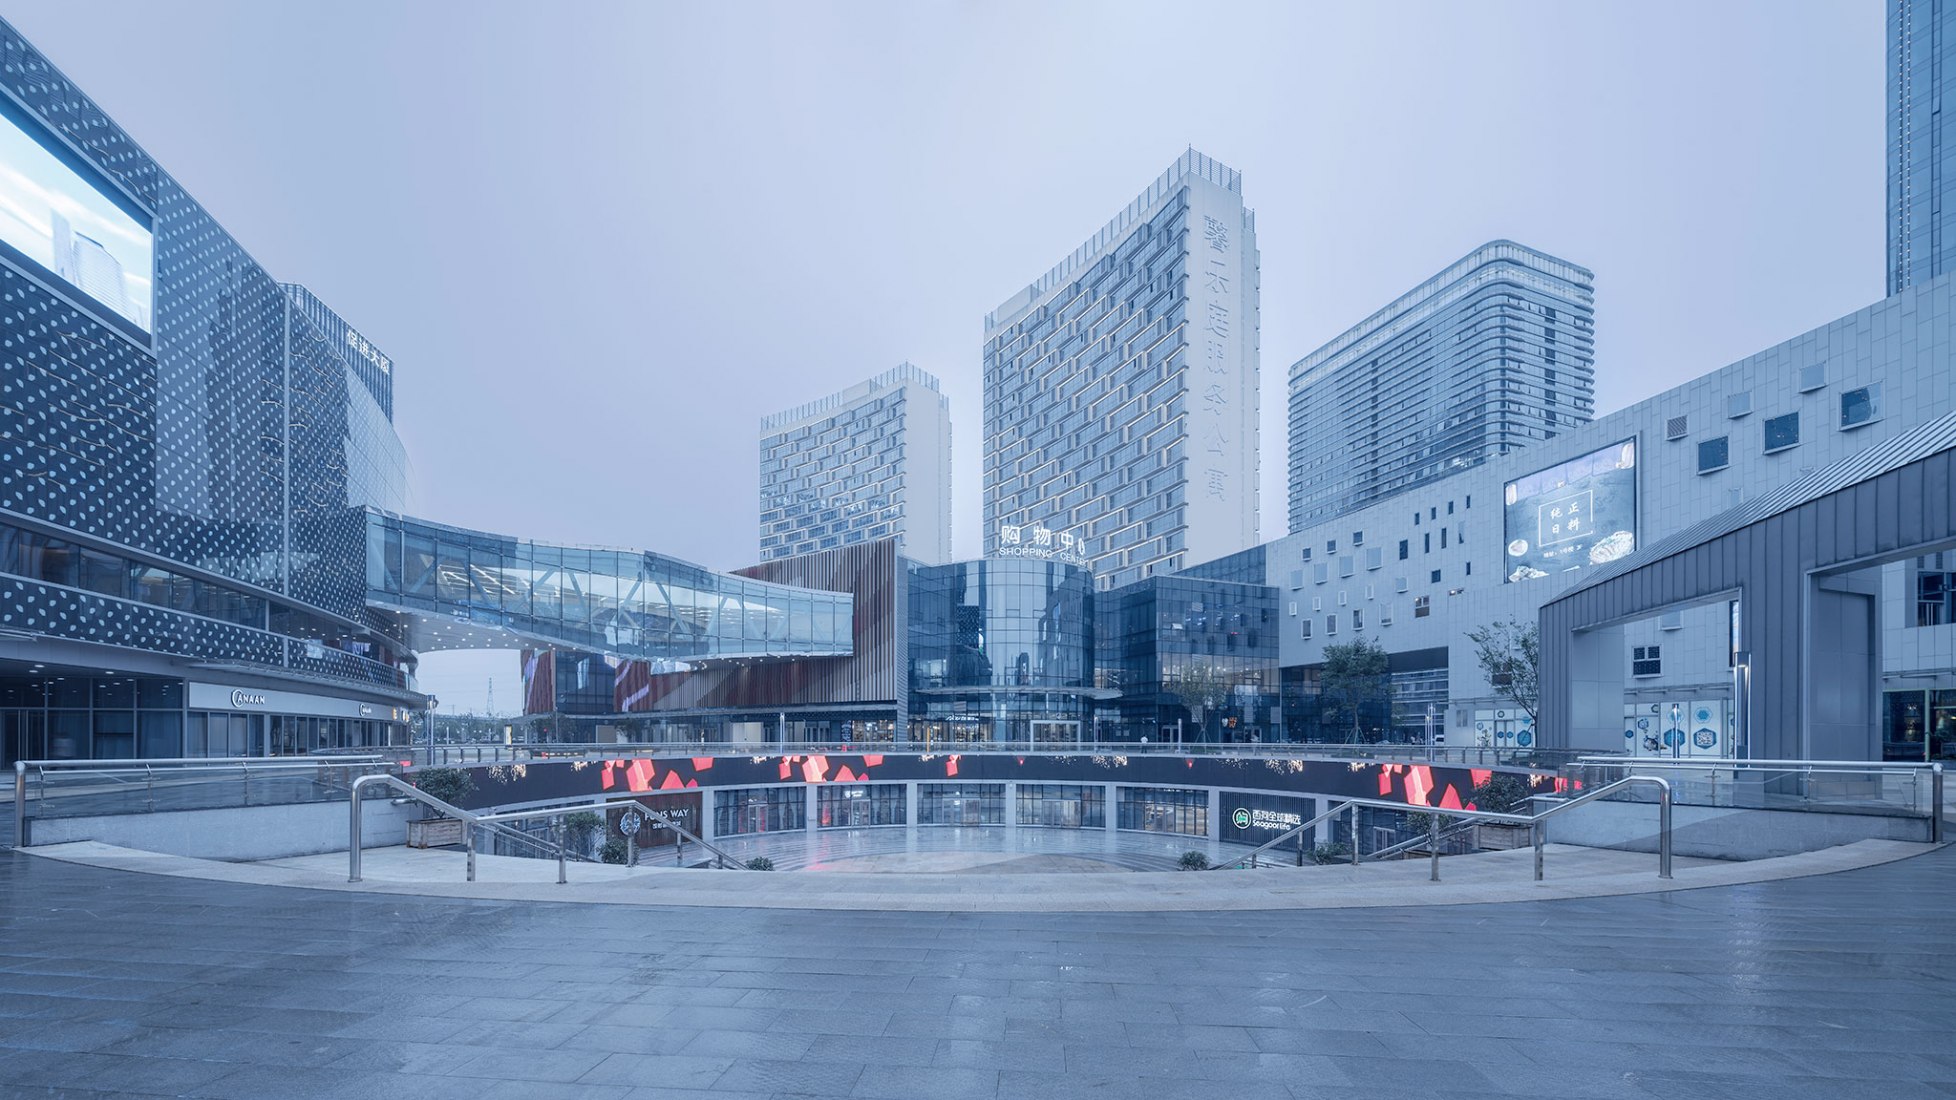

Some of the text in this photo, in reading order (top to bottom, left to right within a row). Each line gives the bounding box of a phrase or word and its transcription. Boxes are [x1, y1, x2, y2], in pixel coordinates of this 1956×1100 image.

[1001, 525, 1085, 555] 购物中心
[999, 547, 1053, 558] SHOPPING
[231, 689, 265, 708] CANAAN
[670, 809, 689, 818] WAY
